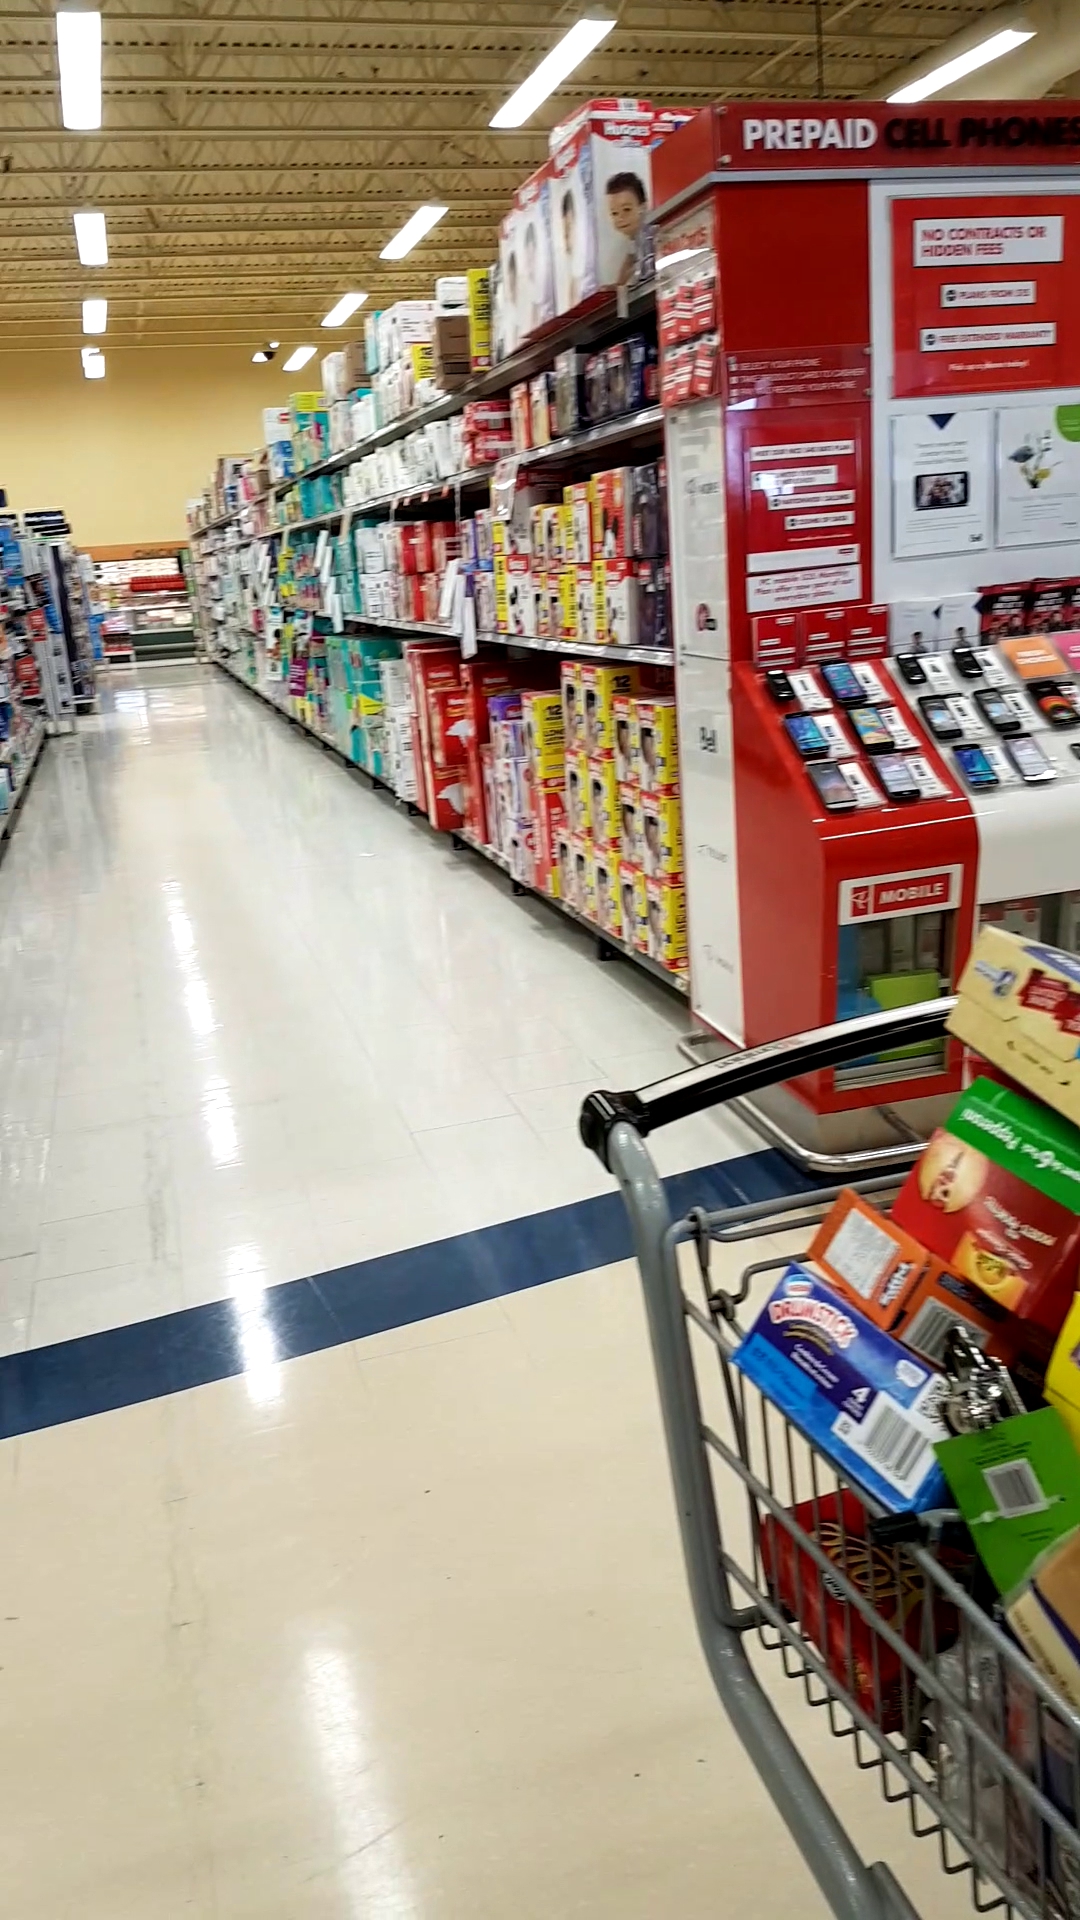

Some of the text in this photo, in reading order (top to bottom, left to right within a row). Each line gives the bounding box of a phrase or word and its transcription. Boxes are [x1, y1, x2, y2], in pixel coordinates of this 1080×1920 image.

[743, 118, 878, 150] PREPAID
[884, 117, 952, 149] CELL
[921, 225, 1047, 241] NO CONTRACTS OR
[921, 243, 1004, 257] HIDDEN FEES
[879, 882, 945, 905] MOBILE
[769, 1297, 859, 1348] DRUMSTICK
[850, 1386, 872, 1404] 4
